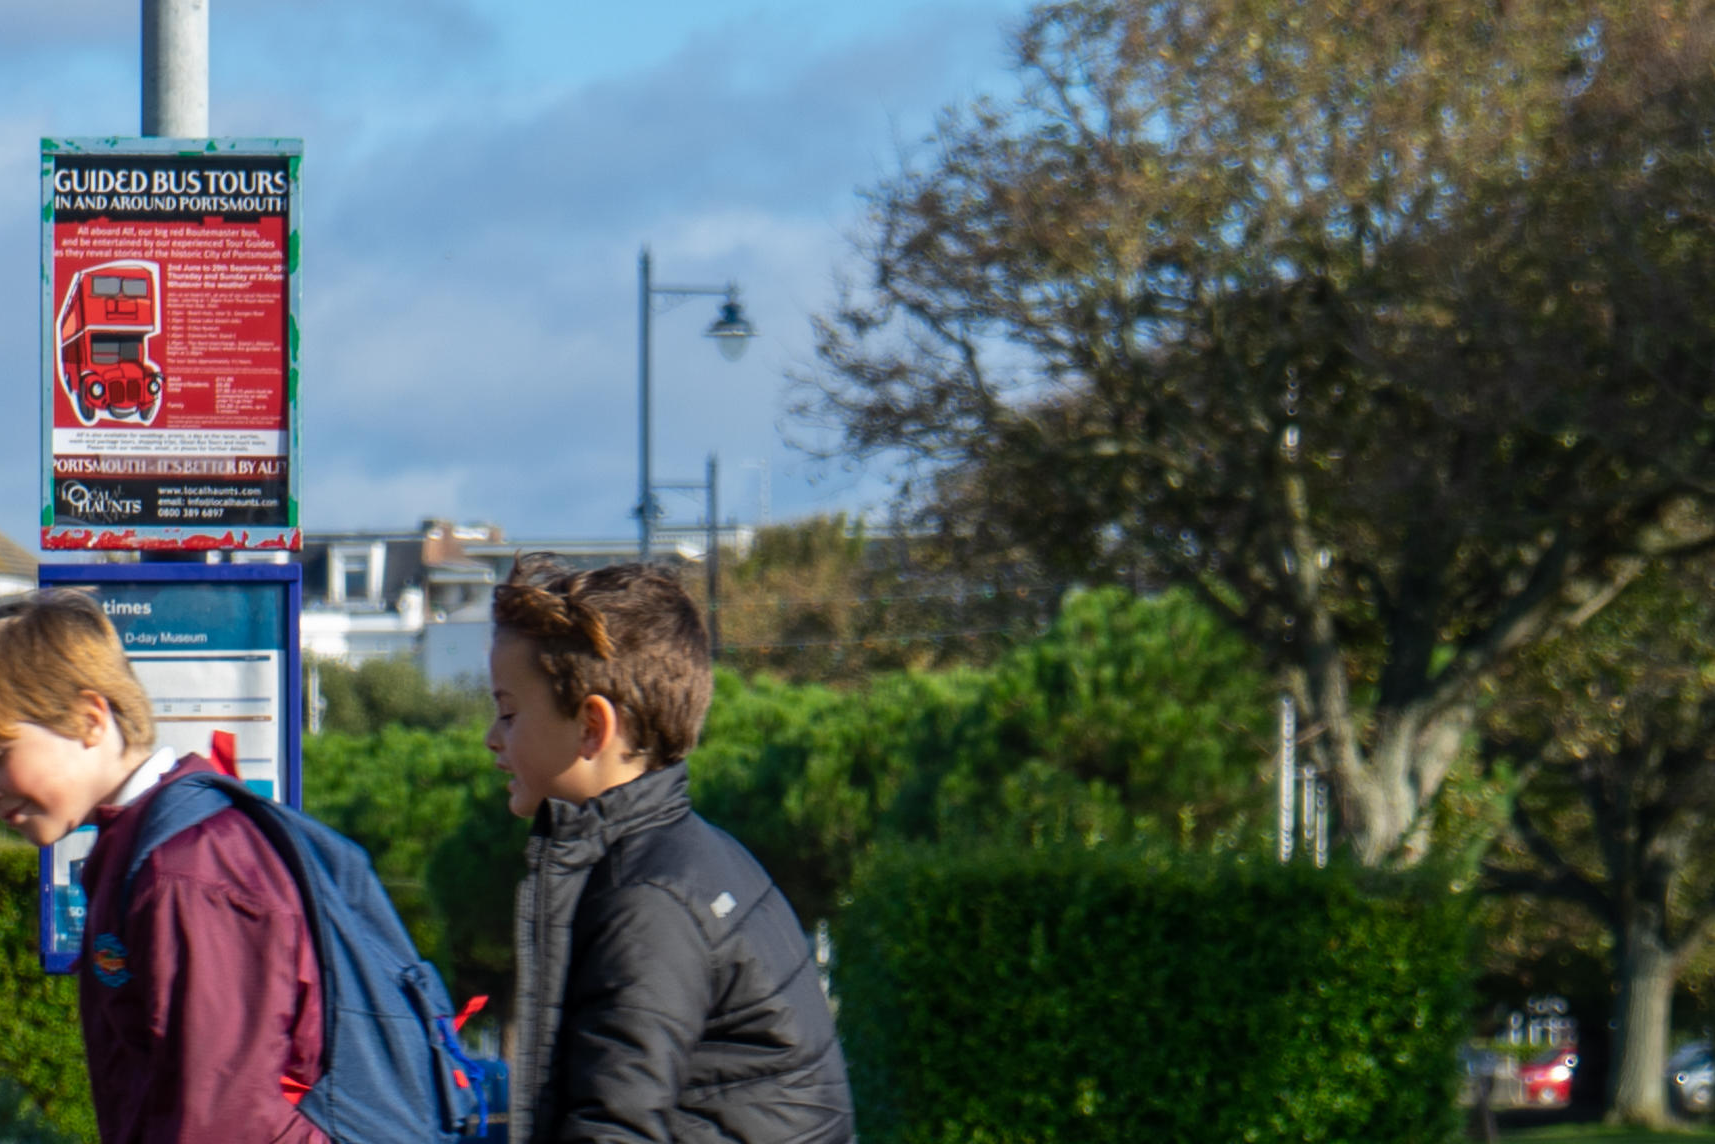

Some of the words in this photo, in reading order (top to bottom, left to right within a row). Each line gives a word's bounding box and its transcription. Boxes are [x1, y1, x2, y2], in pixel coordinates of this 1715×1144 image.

[54, 168, 147, 194] GUIDED
[151, 169, 201, 194] BUS
[203, 170, 287, 195] TOURS
[54, 194, 72, 210] IN
[74, 195, 106, 211] AND
[109, 195, 177, 211] AROUND
[179, 196, 287, 212] PORTSMOUTH
[184, 459, 236, 475] BETTER
[238, 460, 257, 475] BY
[157, 485, 263, 496] www.localhaunts.com
[77, 499, 142, 514] HAUNTS
[157, 507, 181, 518] 0800
[102, 598, 152, 615] times
[125, 632, 158, 646] D-day
[160, 632, 208, 644] Museum
